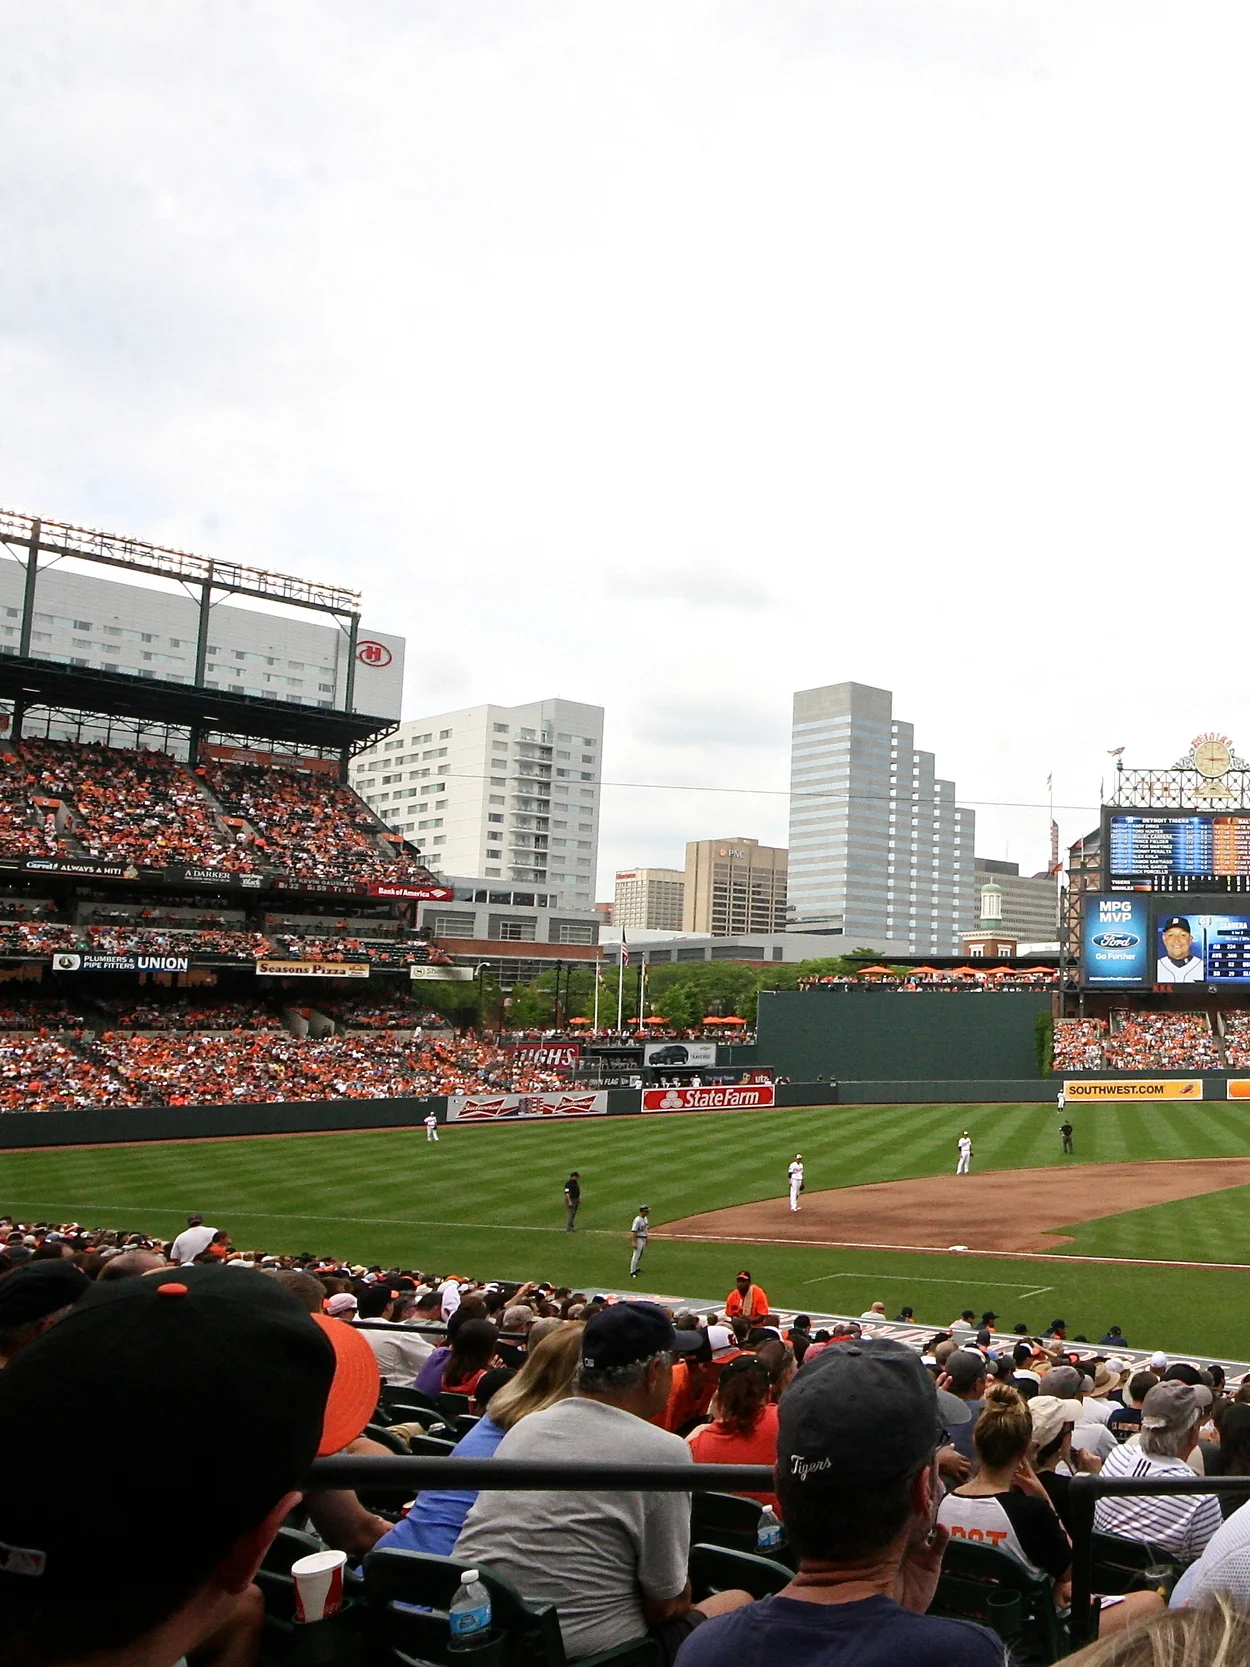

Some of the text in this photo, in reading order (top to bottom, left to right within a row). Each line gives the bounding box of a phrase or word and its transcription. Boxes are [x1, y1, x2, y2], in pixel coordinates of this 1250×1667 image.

[728, 850, 744, 859] PNC
[60, 864, 94, 873] ALWAYS
[193, 870, 230, 879] DARKER
[378, 887, 395, 896] Bank
[402, 890, 430, 898] America
[1100, 901, 1132, 912] MPG
[1099, 912, 1132, 923] MVP
[1100, 933, 1130, 947] Ford
[84, 955, 126, 963] PLUMBERS
[137, 957, 188, 969] UNION
[104, 962, 135, 970] FITTERS
[260, 963, 309, 974] Seasons
[312, 964, 347, 975] Pizza
[1069, 1085, 1164, 1095] SOUTHWEST.COM
[463, 1103, 501, 1113] Budweiser
[560, 1099, 593, 1108] Budweiser
[790, 1454, 832, 1481] Tigers
